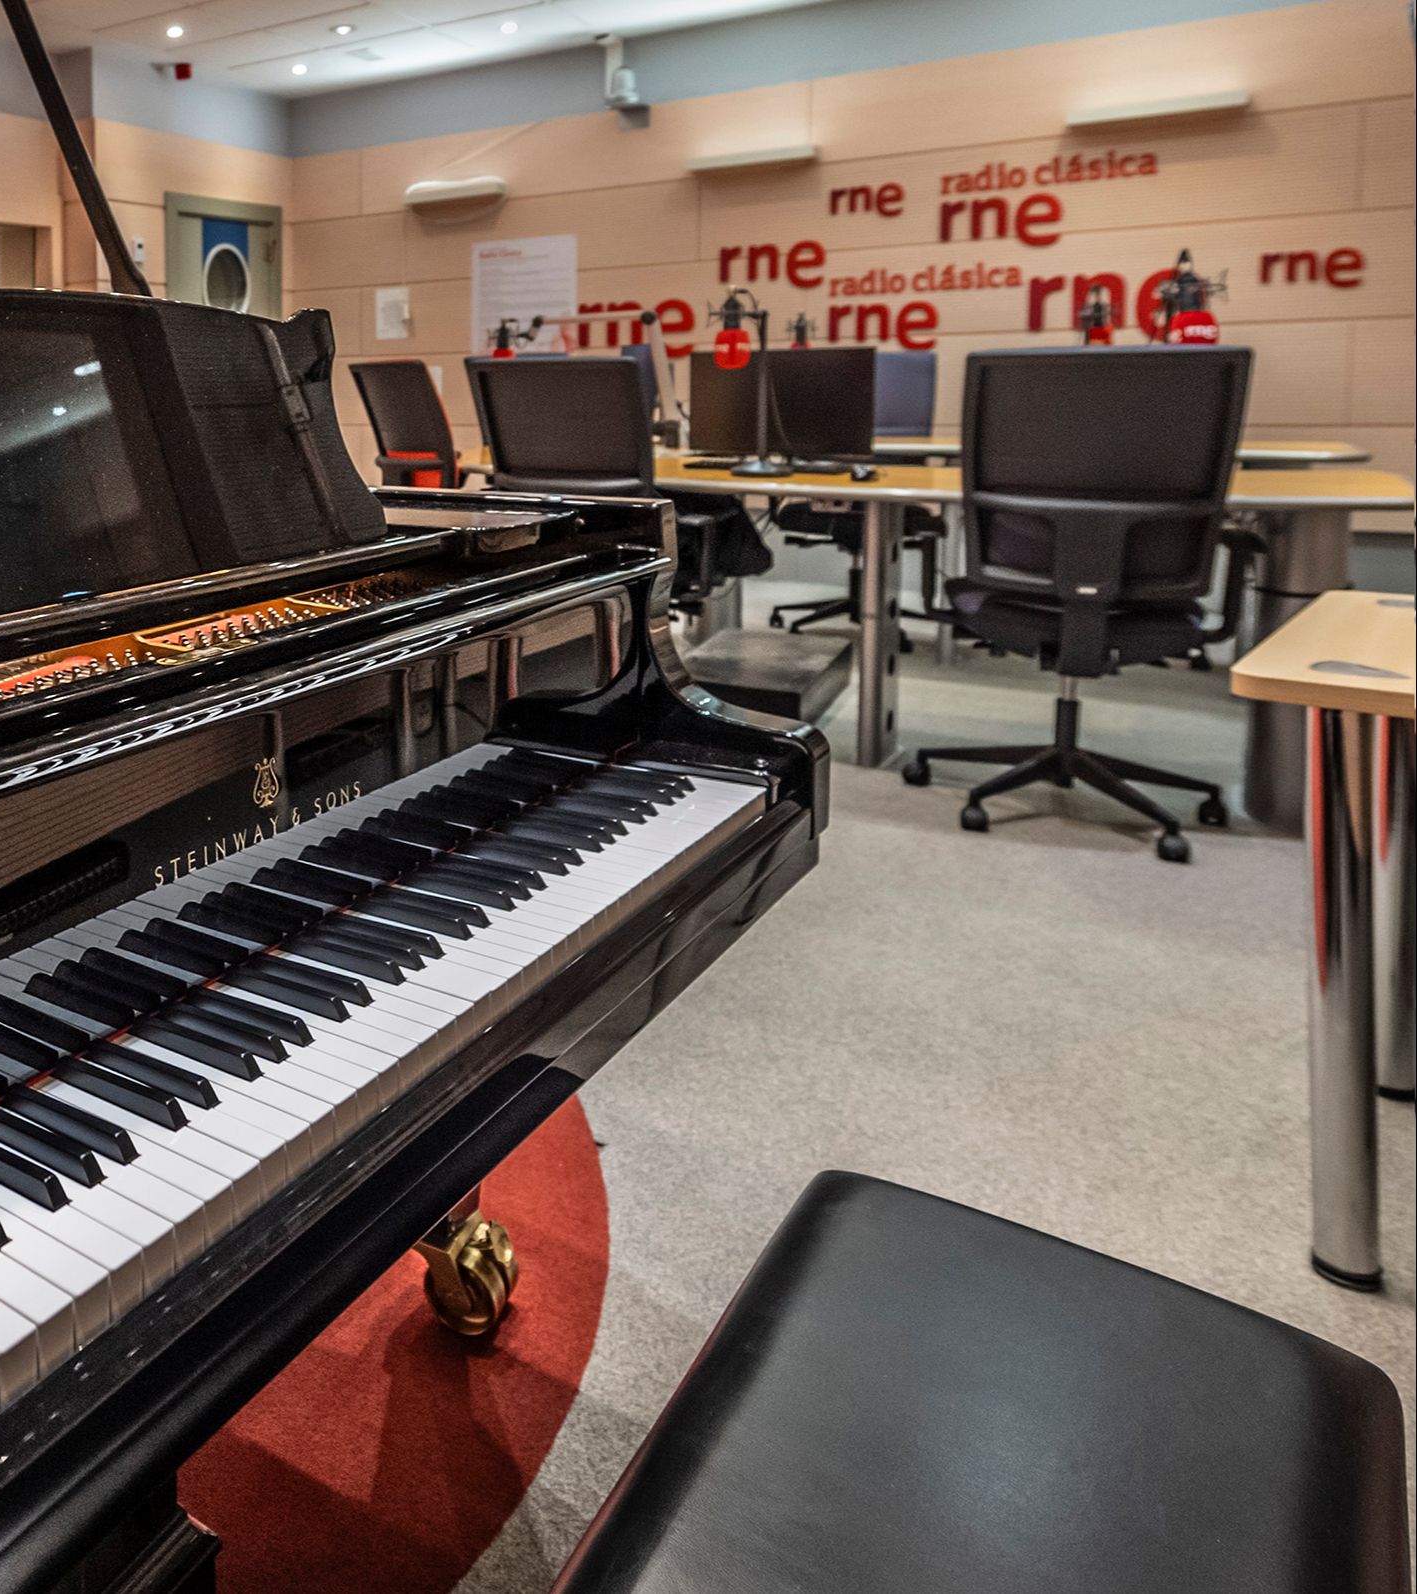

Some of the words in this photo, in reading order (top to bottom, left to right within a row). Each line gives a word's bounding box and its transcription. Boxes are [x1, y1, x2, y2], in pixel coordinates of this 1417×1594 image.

[939, 163, 1027, 195] radio
[1034, 150, 1158, 186] clásica
[828, 182, 904, 218] rne
[938, 193, 1063, 247] rne
[718, 239, 826, 288] rne
[829, 268, 906, 297] radio
[911, 263, 1023, 291] clásica
[1258, 247, 1365, 288] rne
[578, 298, 695, 358] rne
[827, 300, 939, 350] rne
[153, 815, 279, 888] STEINWAY
[292, 806, 301, 827] &
[313, 780, 361, 817] SONS
